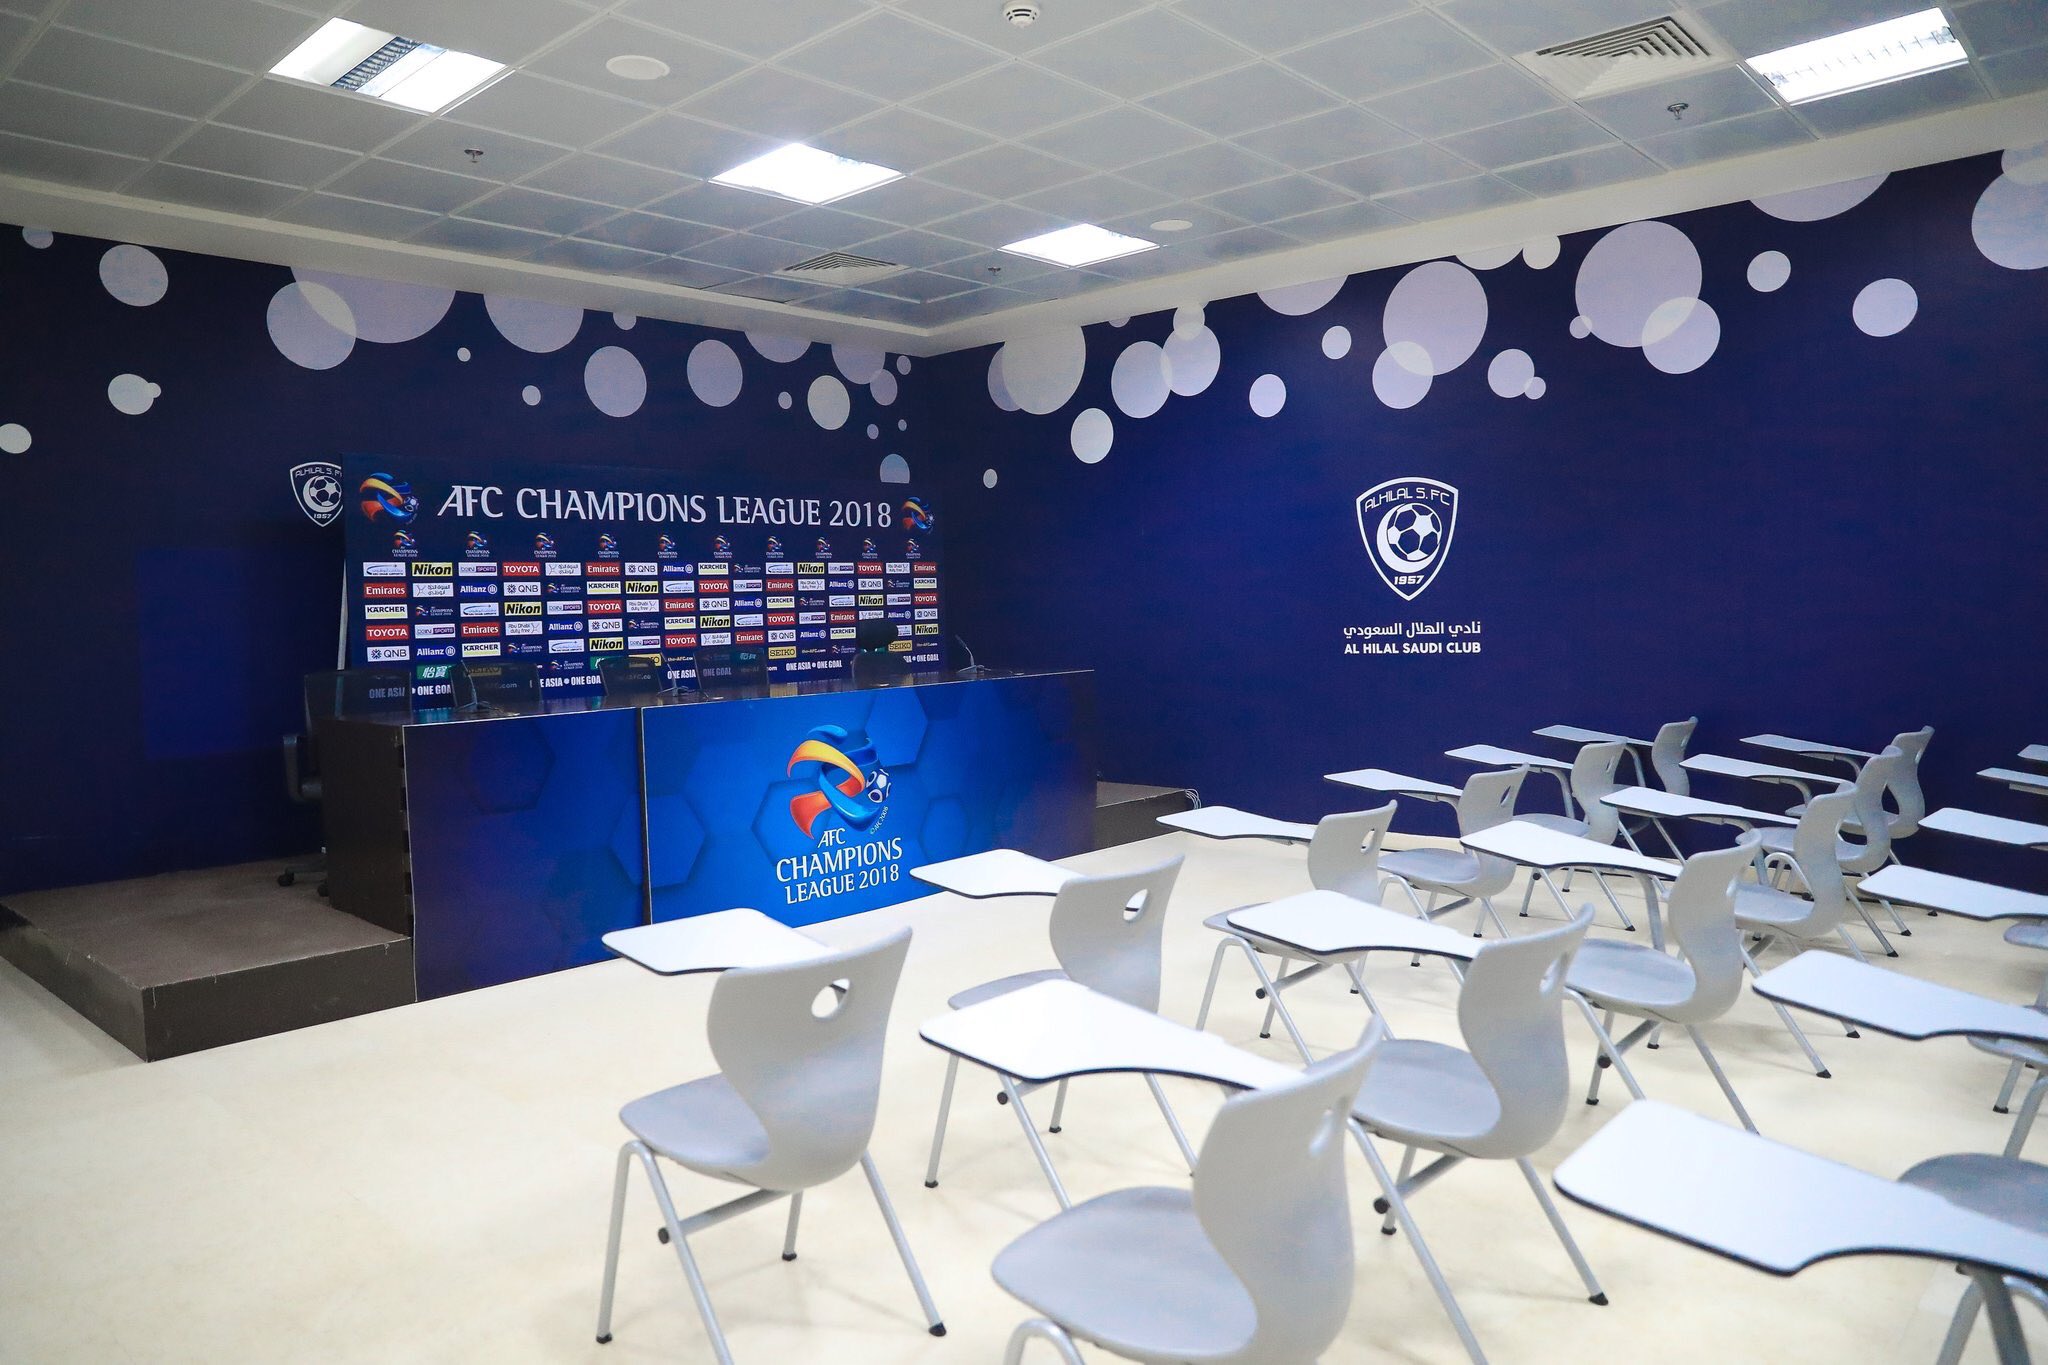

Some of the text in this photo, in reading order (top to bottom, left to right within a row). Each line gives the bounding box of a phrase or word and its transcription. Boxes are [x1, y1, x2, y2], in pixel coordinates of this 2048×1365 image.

[437, 485, 892, 528] AFC CHAMPIONS LEAGUE 2018
[414, 564, 451, 575] Nikon
[799, 564, 823, 572] Nikon
[1394, 575, 1424, 585] 1957
[366, 586, 405, 594] Emirates
[518, 585, 538, 593] QNB
[627, 583, 657, 592] Nikon
[711, 600, 728, 608] QNB
[860, 596, 882, 604] Nikon
[506, 604, 540, 614] Nikon
[602, 622, 620, 630] QNB
[702, 617, 729, 626] Nikon
[368, 628, 407, 637] TOYOTA
[463, 626, 498, 635] Emirates
[916, 625, 937, 633] Nikon
[1344, 621, 1481, 639] نادي الهلال السعودي
[591, 640, 622, 649] Nikon
[1344, 642, 1481, 654] AL HILAL SAUDI CLUB
[384, 649, 406, 657] QNB
[417, 648, 444, 656] Allianz
[770, 649, 795, 657] SEIKO
[786, 663, 797, 671] ONE
[798, 662, 811, 670] ASIA
[817, 661, 827, 669] ONE
[829, 660, 842, 668] GOAL
[681, 669, 696, 678] ASIA
[546, 677, 563, 687] ASIA
[571, 676, 585, 685] ONE
[587, 675, 601, 684] GOA
[418, 685, 434, 695] ONE
[436, 685, 451, 694] GOA
[818, 828, 845, 848] AFC
[776, 837, 902, 883] CHAMPIONS
[785, 863, 899, 904] LEAGUE 2018
